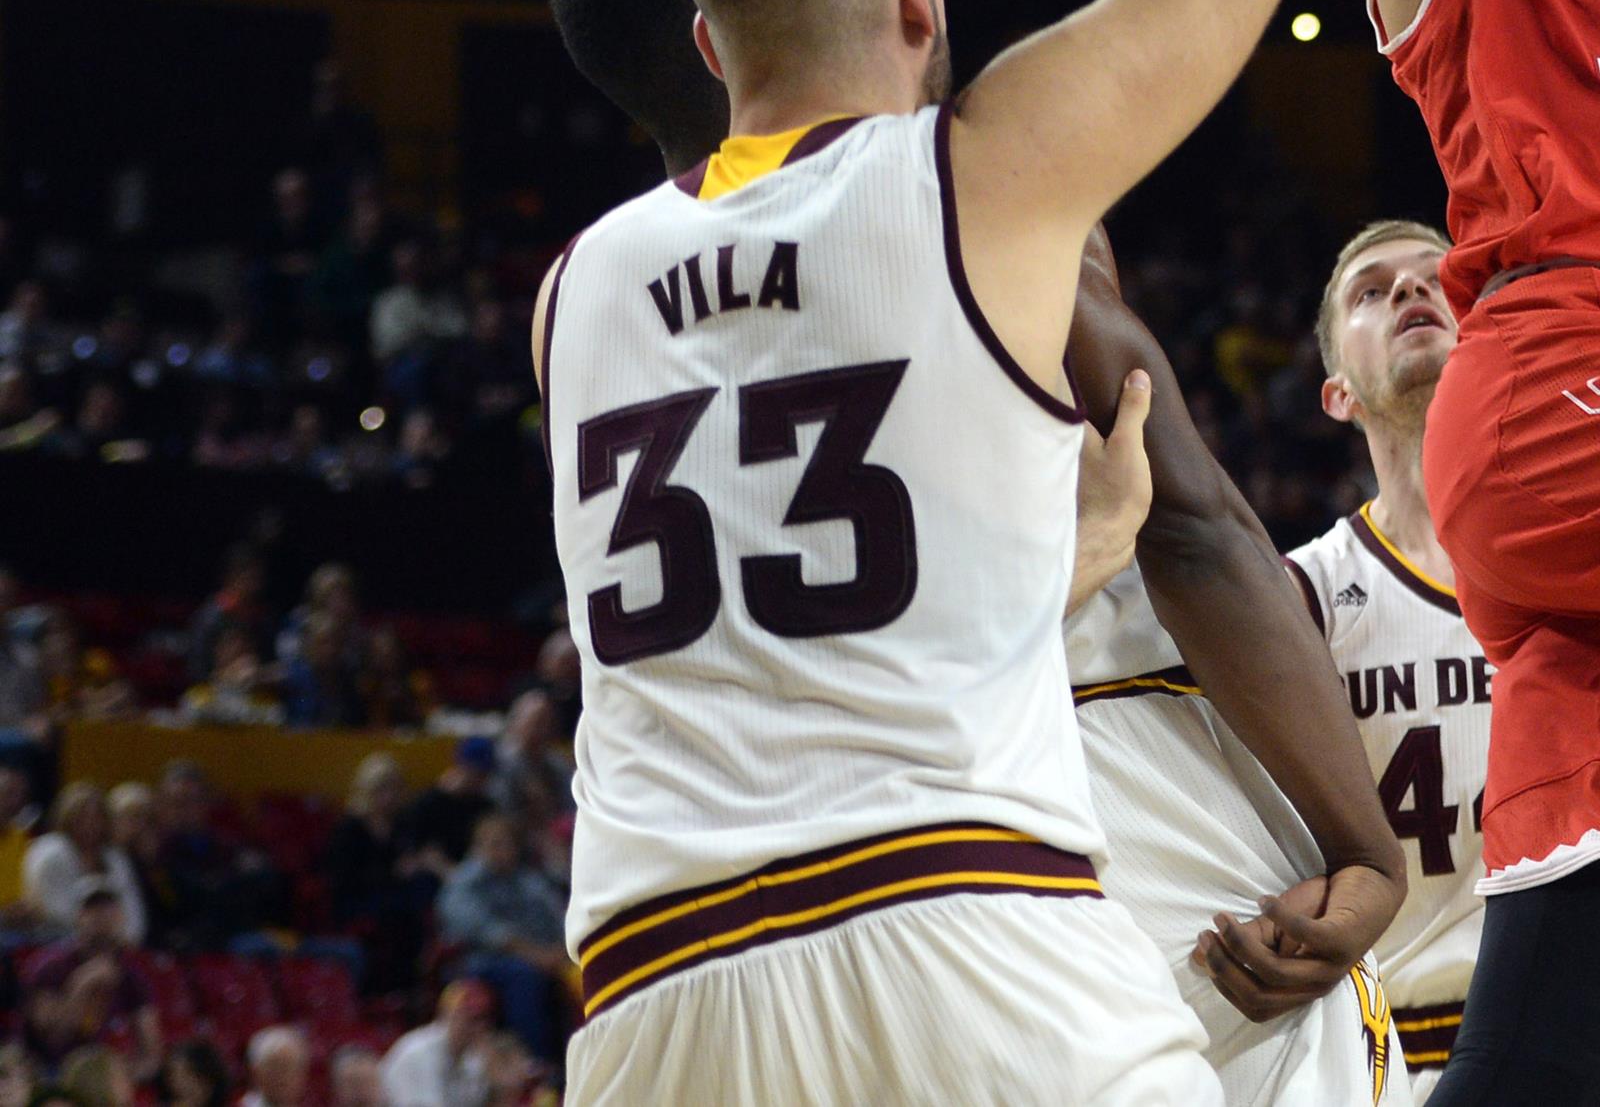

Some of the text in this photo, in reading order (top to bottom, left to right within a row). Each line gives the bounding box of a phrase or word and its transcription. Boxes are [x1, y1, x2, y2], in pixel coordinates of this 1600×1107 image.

[647, 241, 801, 337] VILA
[577, 358, 918, 667] 33
[1341, 656, 1493, 719] UN DE
[1378, 725, 1488, 878] 4
